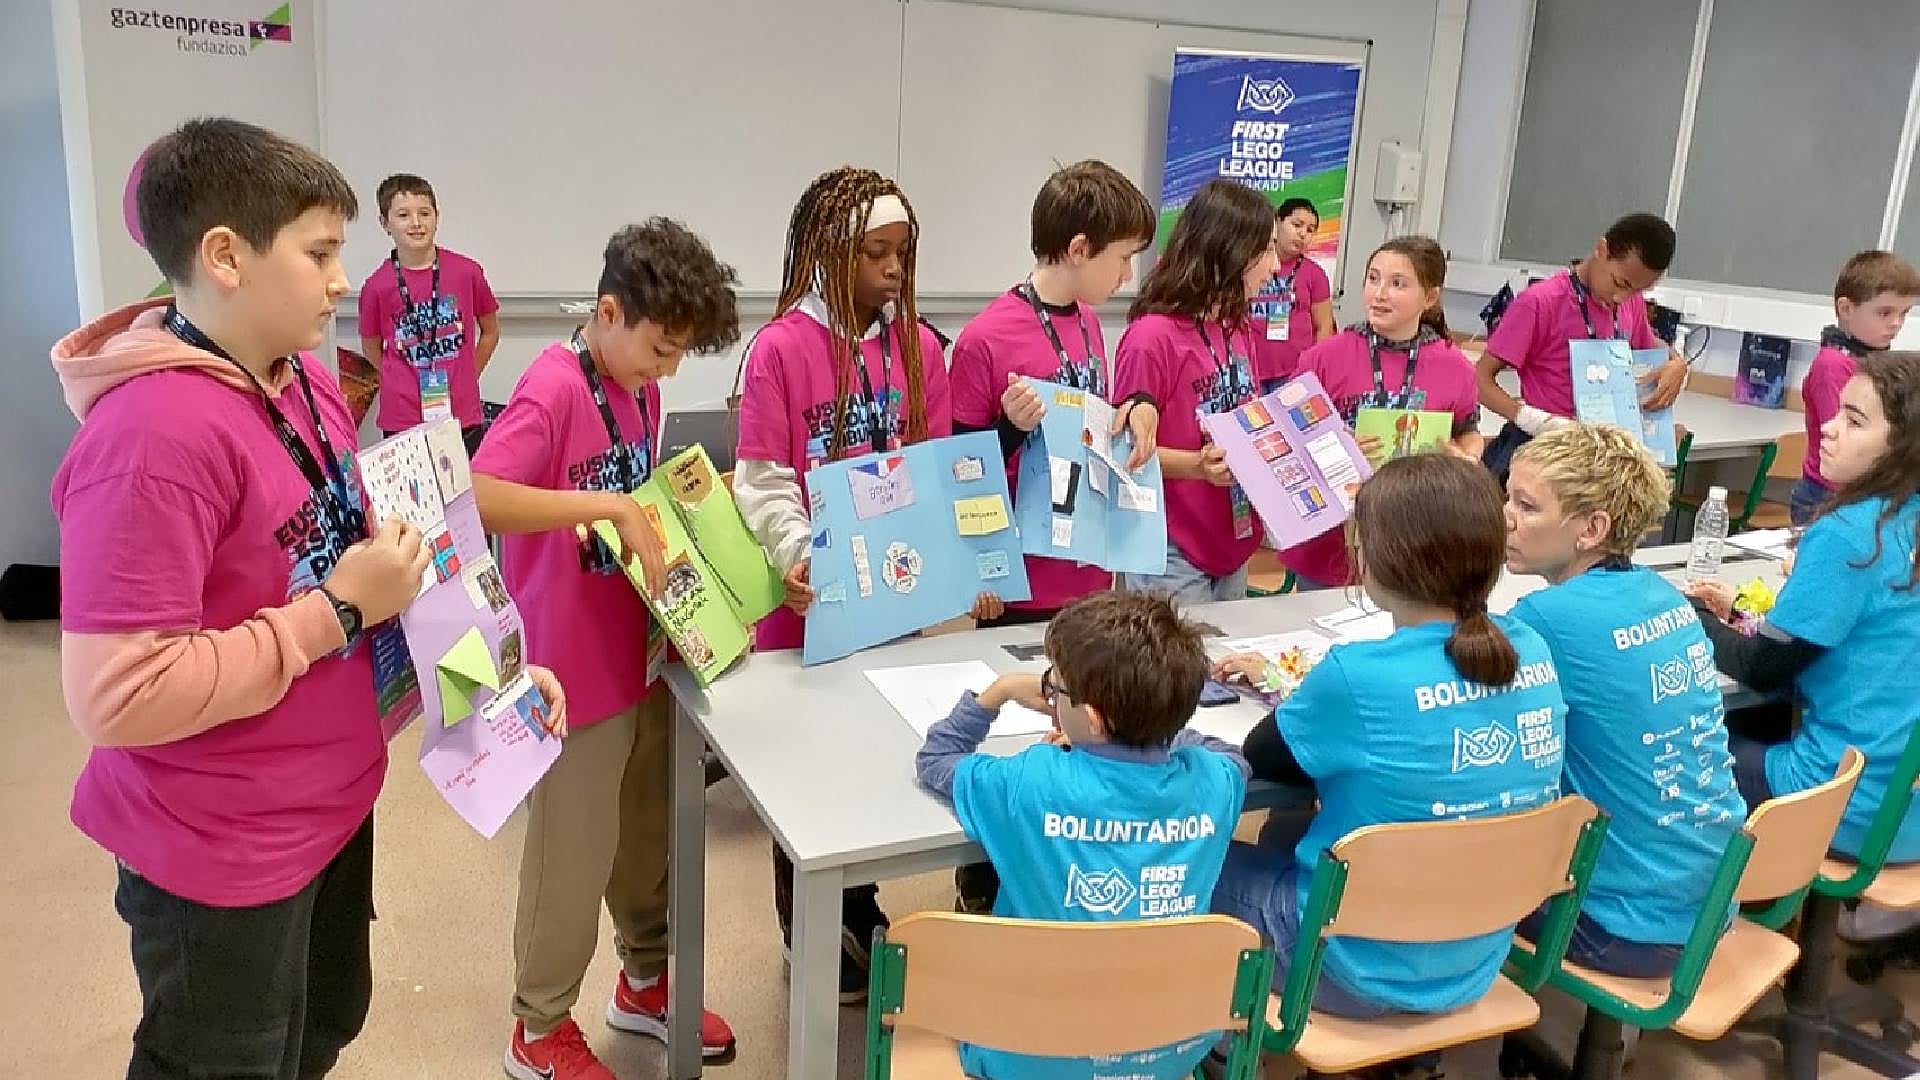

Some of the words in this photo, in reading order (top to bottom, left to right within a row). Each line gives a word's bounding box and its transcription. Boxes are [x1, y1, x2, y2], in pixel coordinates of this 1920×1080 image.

[111, 7, 245, 37] gaztenpresa
[177, 36, 247, 57] fundazioa
[1231, 120, 1290, 141] FIRST
[1231, 140, 1284, 160] LEGO
[1219, 157, 1294, 179] LEAGUE
[1516, 706, 1553, 730] FIRST
[1518, 723, 1553, 746] LEGO
[1043, 812, 1216, 843] BOLUNTARIOA
[1139, 863, 1188, 883] FIRST
[1139, 881, 1183, 900] LEGO
[1139, 894, 1197, 917] LEAGUE
